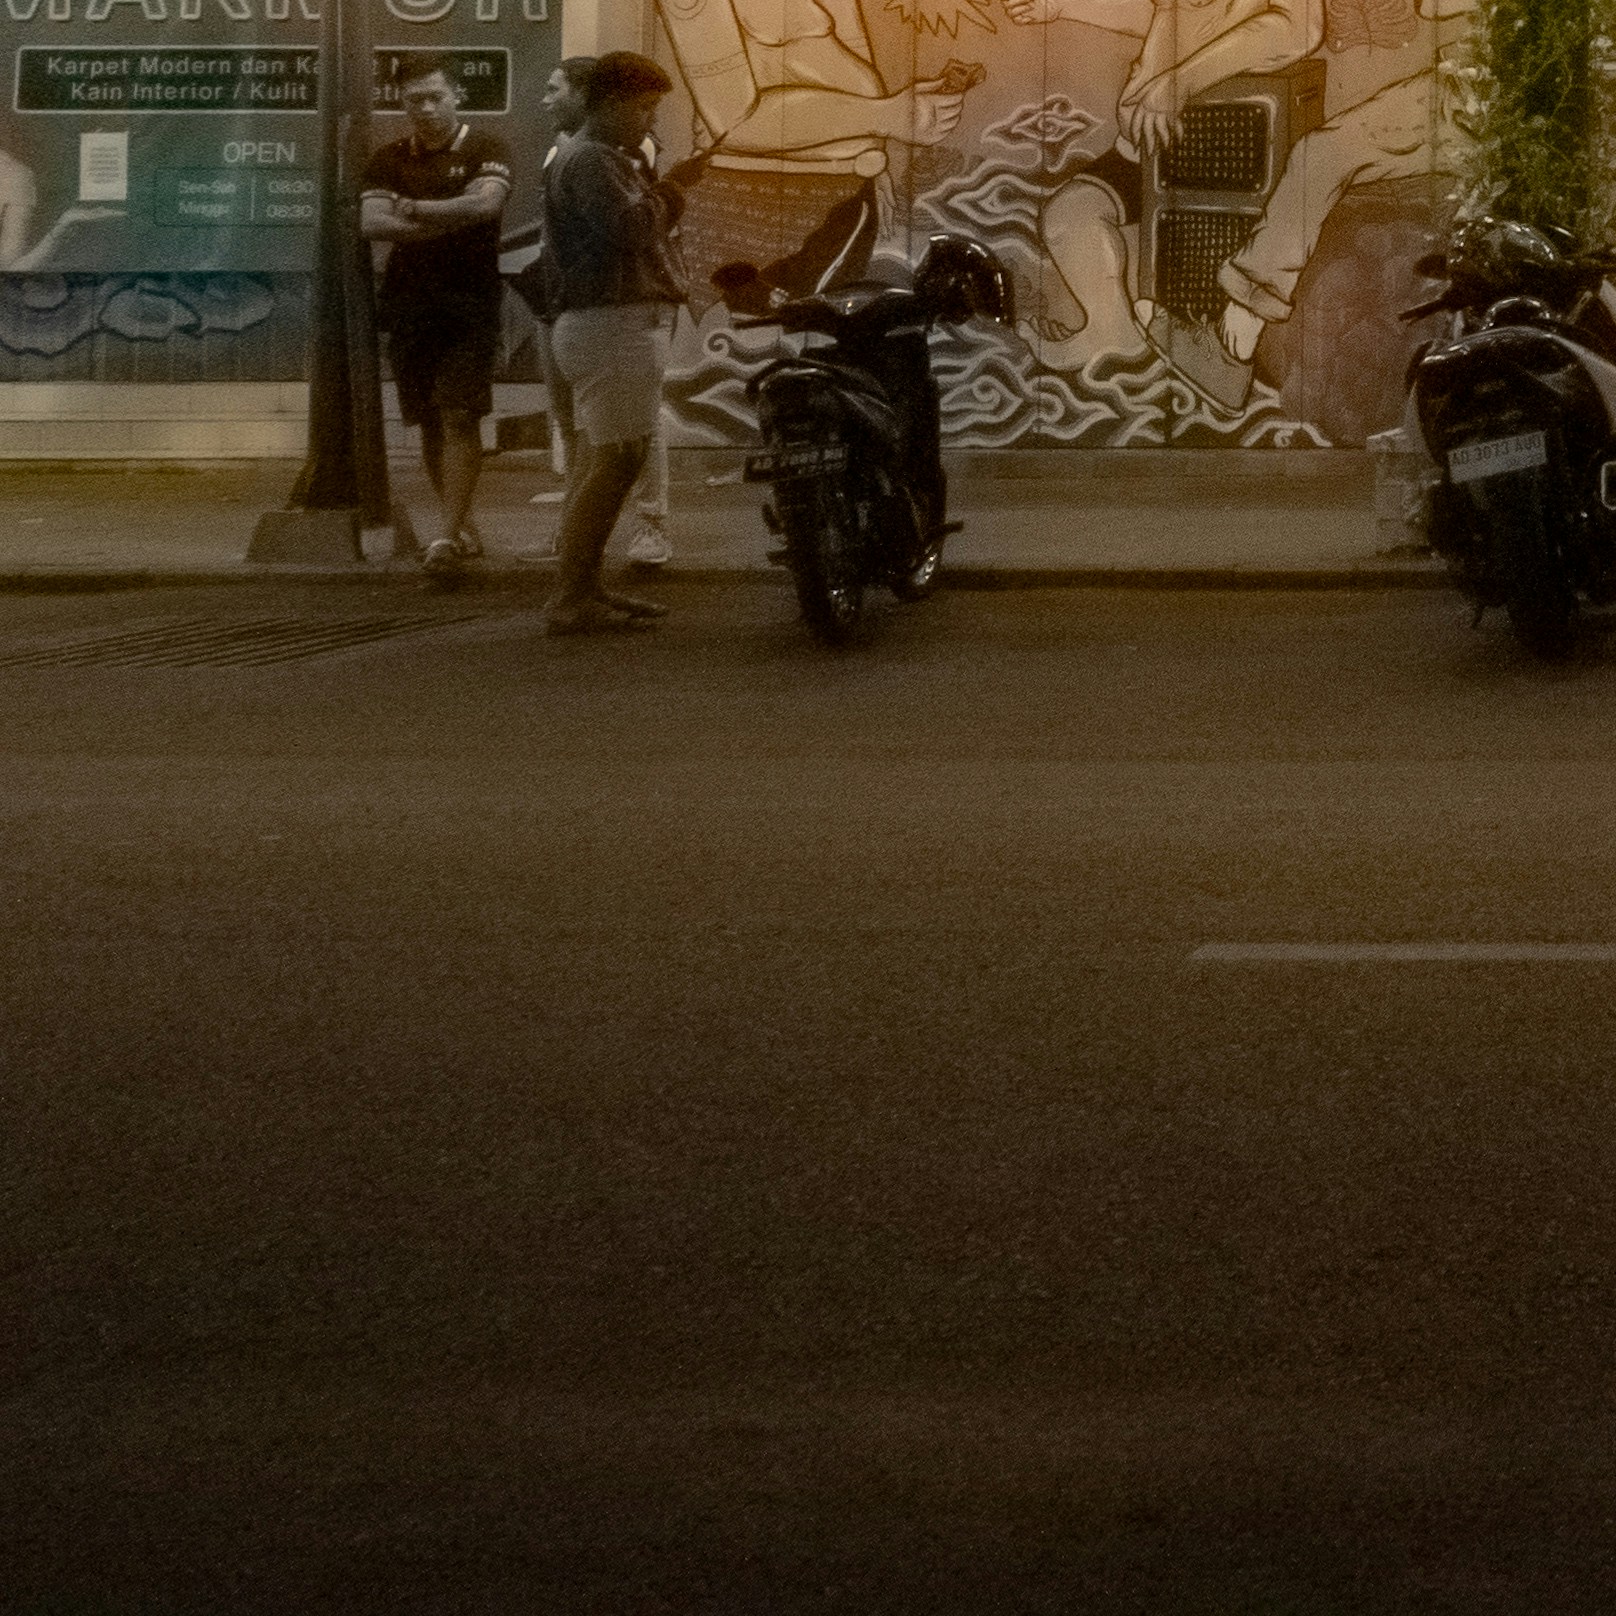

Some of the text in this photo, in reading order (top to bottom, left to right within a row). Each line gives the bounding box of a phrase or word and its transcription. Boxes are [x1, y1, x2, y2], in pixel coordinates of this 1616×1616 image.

[47, 57, 130, 79] Karpet
[139, 57, 232, 75] Modern
[241, 57, 284, 75] dan
[71, 83, 122, 101] Kain
[133, 83, 223, 101] Interior
[251, 83, 308, 101] Kulit
[223, 141, 296, 164] OPEN
